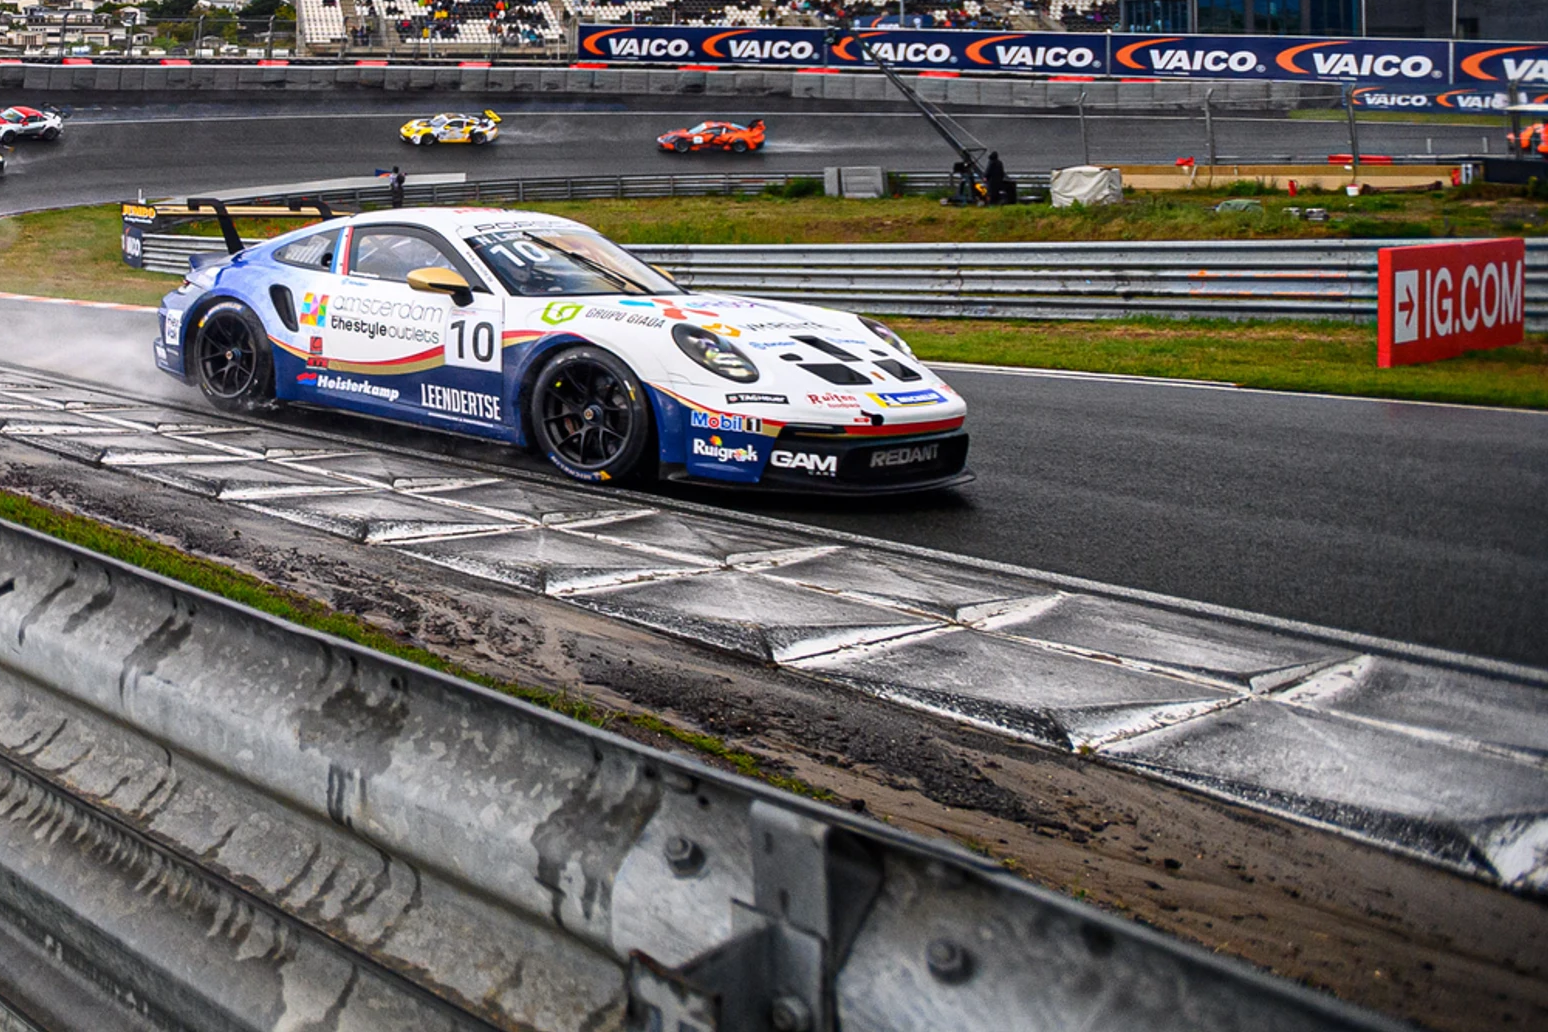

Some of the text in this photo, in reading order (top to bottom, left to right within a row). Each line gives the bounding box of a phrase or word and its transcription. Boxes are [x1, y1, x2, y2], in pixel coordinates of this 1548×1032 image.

[608, 38, 690, 57] VAICO
[729, 39, 815, 59] VAICO
[862, 42, 952, 62] VAICO
[995, 45, 1094, 67] VAICO
[1149, 49, 1257, 72] VAICO
[1313, 52, 1434, 78] VAICO
[1363, 93, 1428, 106] VAICO
[489, 240, 550, 267] 10
[332, 294, 443, 324] amsterdam
[1425, 259, 1522, 339] IG.COM
[585, 307, 666, 329] GRUPO GIADA
[450, 319, 494, 363] 10
[317, 375, 400, 402] Heisterkamp
[420, 383, 502, 421] LEENDERTSE
[691, 410, 743, 431] Mobil
[693, 438, 758, 462] Ruigrok
[771, 450, 838, 472] GAM
[870, 444, 940, 468] REDANT
